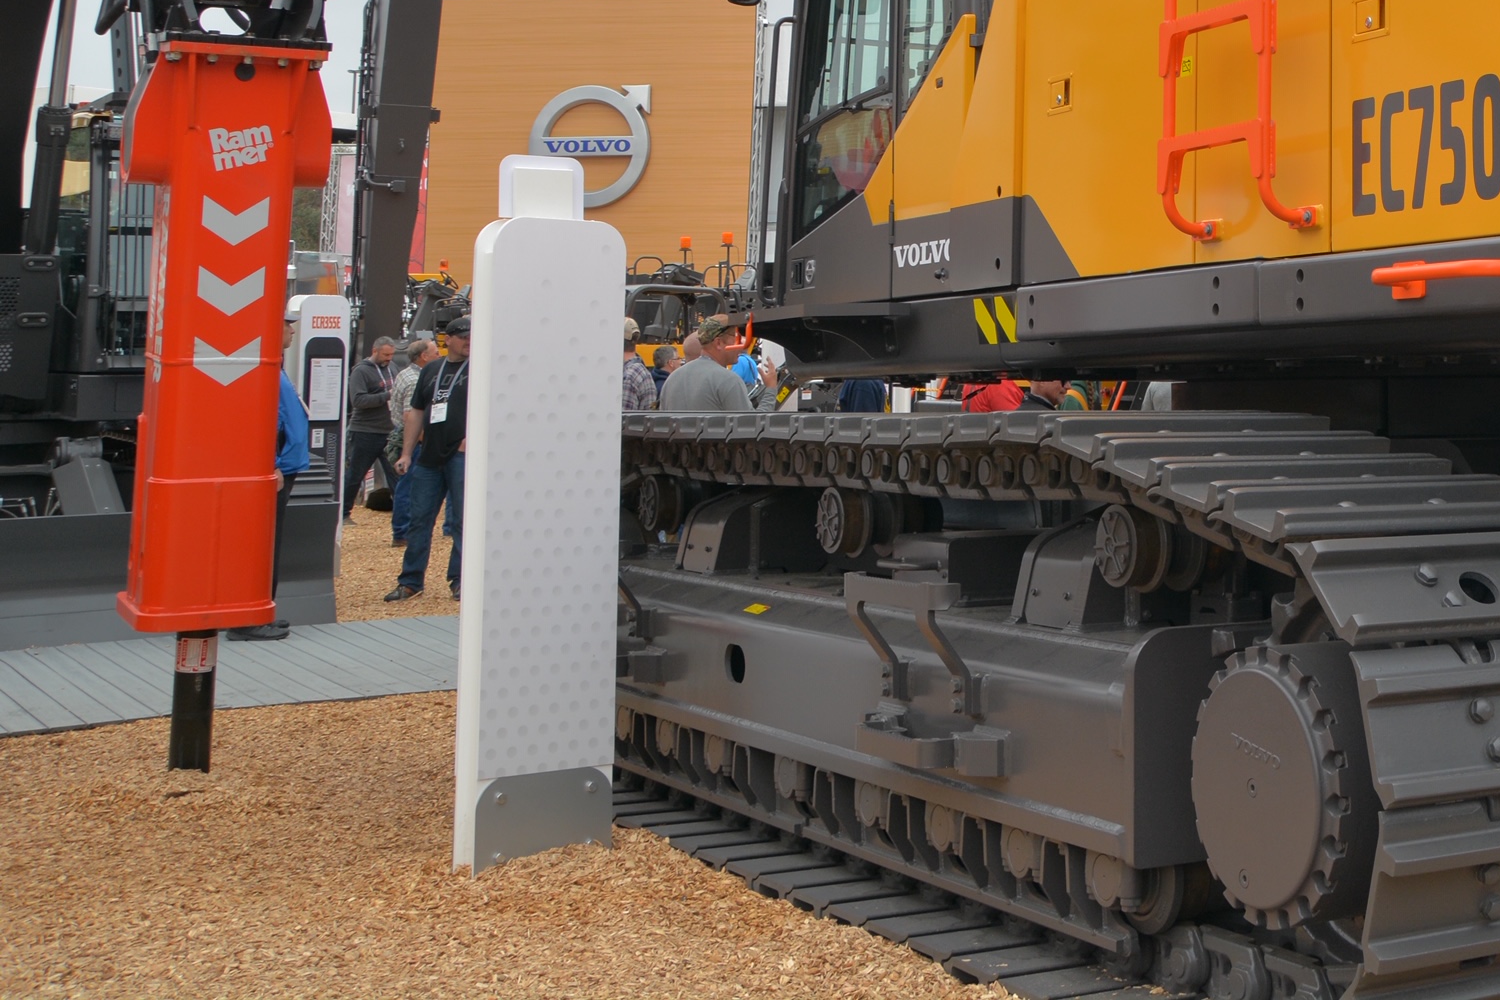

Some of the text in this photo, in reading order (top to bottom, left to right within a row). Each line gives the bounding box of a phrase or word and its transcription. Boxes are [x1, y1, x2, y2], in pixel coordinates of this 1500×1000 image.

[208, 125, 273, 154] Ram
[543, 139, 631, 153] VOLVO
[212, 143, 269, 172] mer
[152, 192, 170, 384] RAMMER
[312, 315, 341, 329] ECR355E
[326, 432, 338, 483] OMORROW
[1231, 732, 1281, 770] VOLVO
